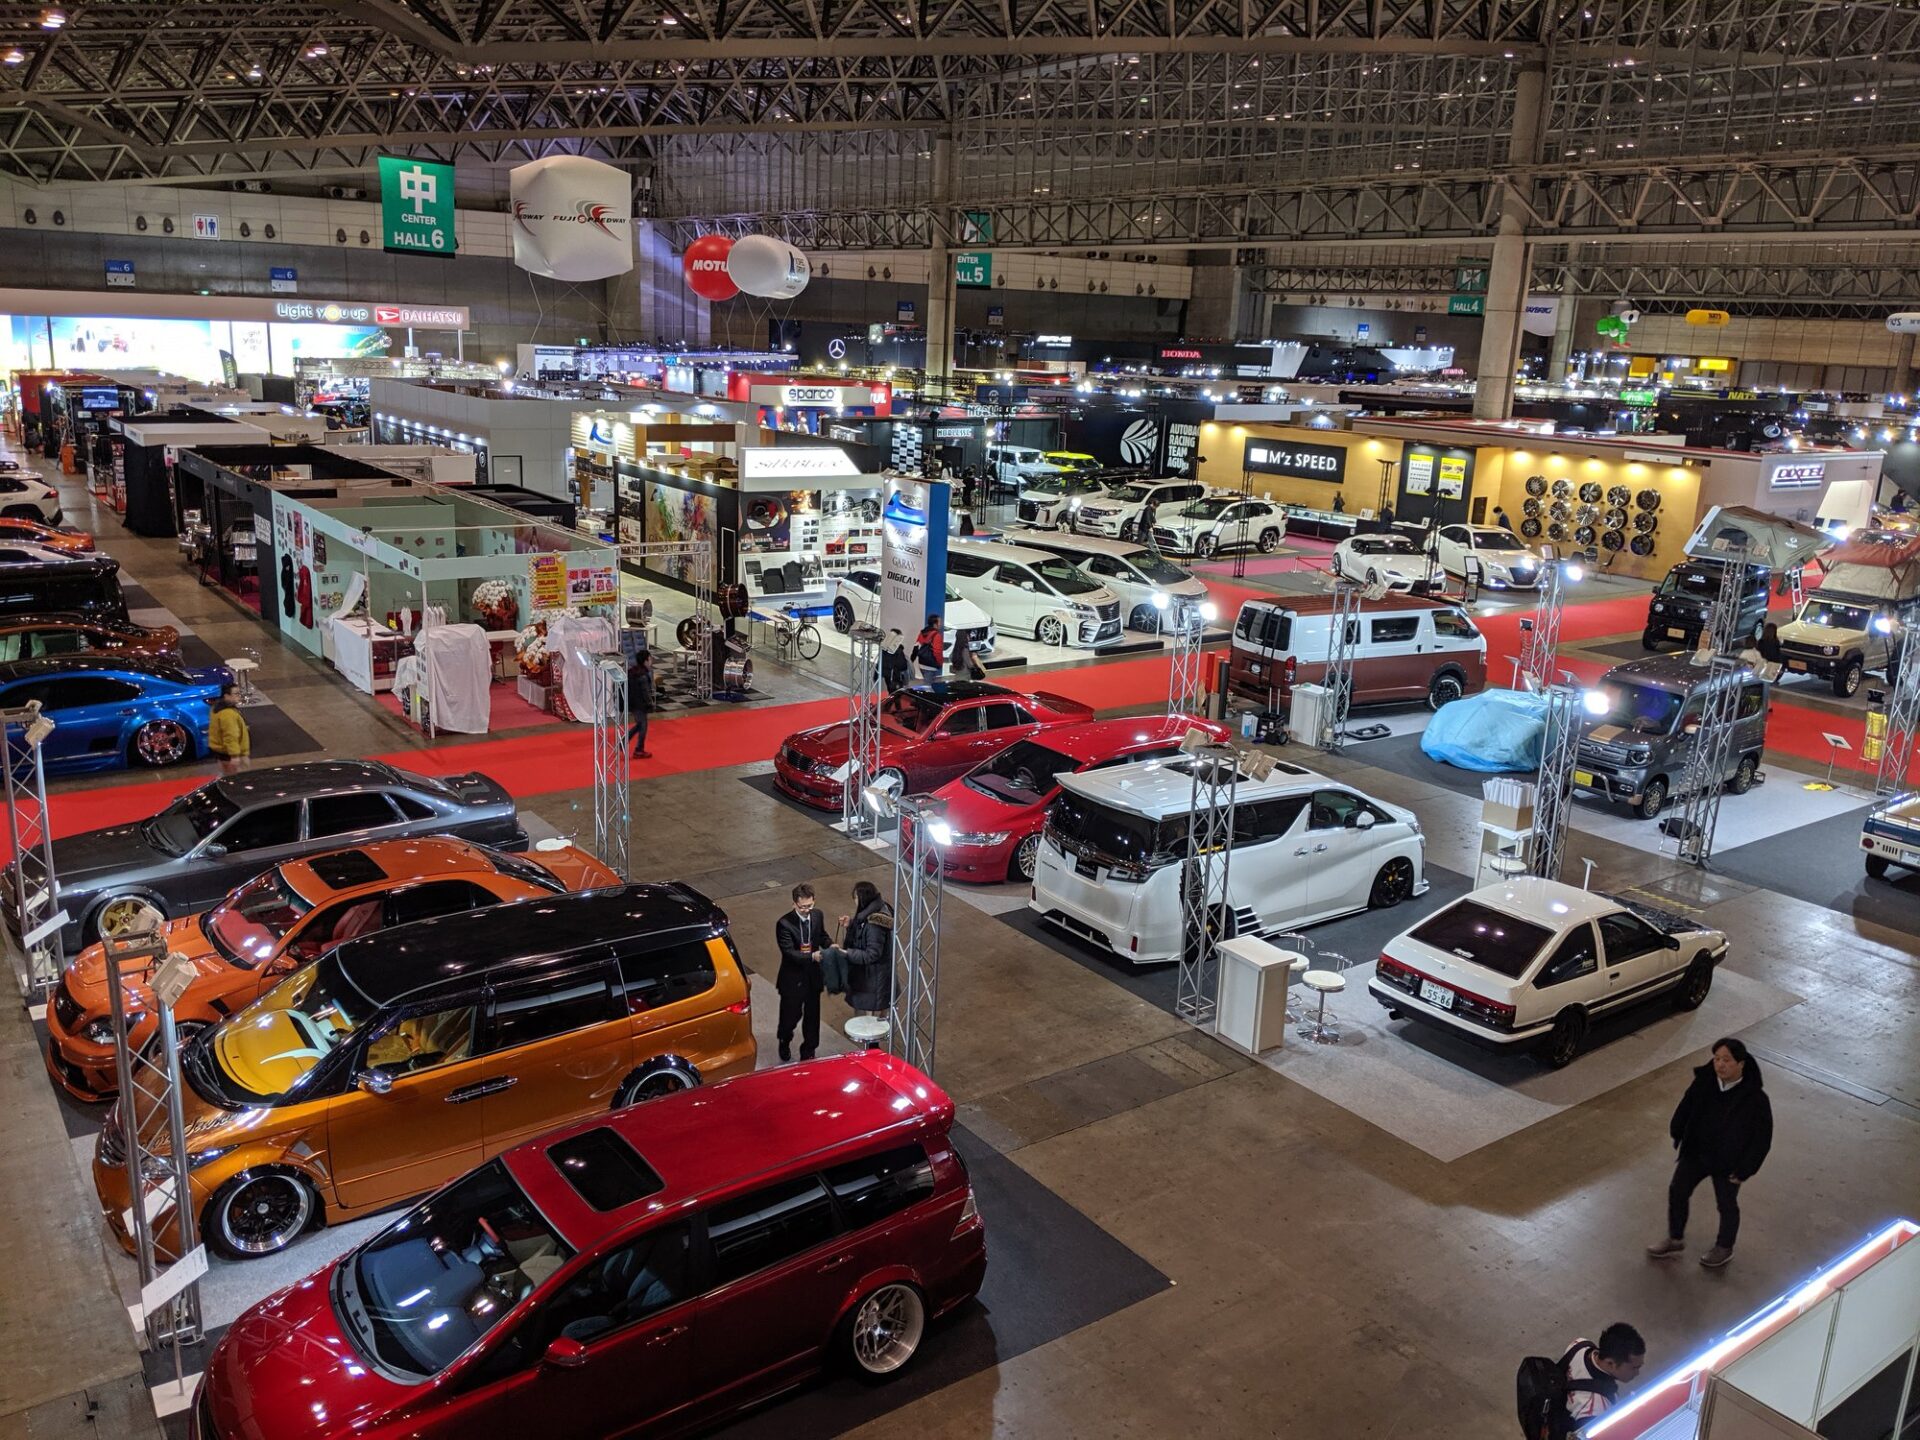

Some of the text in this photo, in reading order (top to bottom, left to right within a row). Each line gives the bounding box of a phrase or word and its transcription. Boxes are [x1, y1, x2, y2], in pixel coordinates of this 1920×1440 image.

[399, 165, 437, 214] 中
[401, 213, 437, 226] CENTER
[394, 229, 445, 249] HALL 6
[692, 259, 728, 273] MOTU
[957, 255, 979, 264] ENTER
[123, 263, 130, 272] 6
[286, 271, 293, 279] 6
[955, 266, 984, 283] ALL 5
[277, 303, 369, 322] Light you up
[1453, 300, 1479, 312] HALL 4
[401, 309, 464, 325] DAIHATSU
[1161, 350, 1202, 359] HONDA
[788, 388, 835, 404] sparco
[1727, 391, 1758, 400] NATS
[1169, 434, 1196, 447] RACING
[1168, 445, 1188, 457] TEAM
[887, 570, 921, 588] DIGICAM
[1426, 989, 1452, 1007] 55-86
